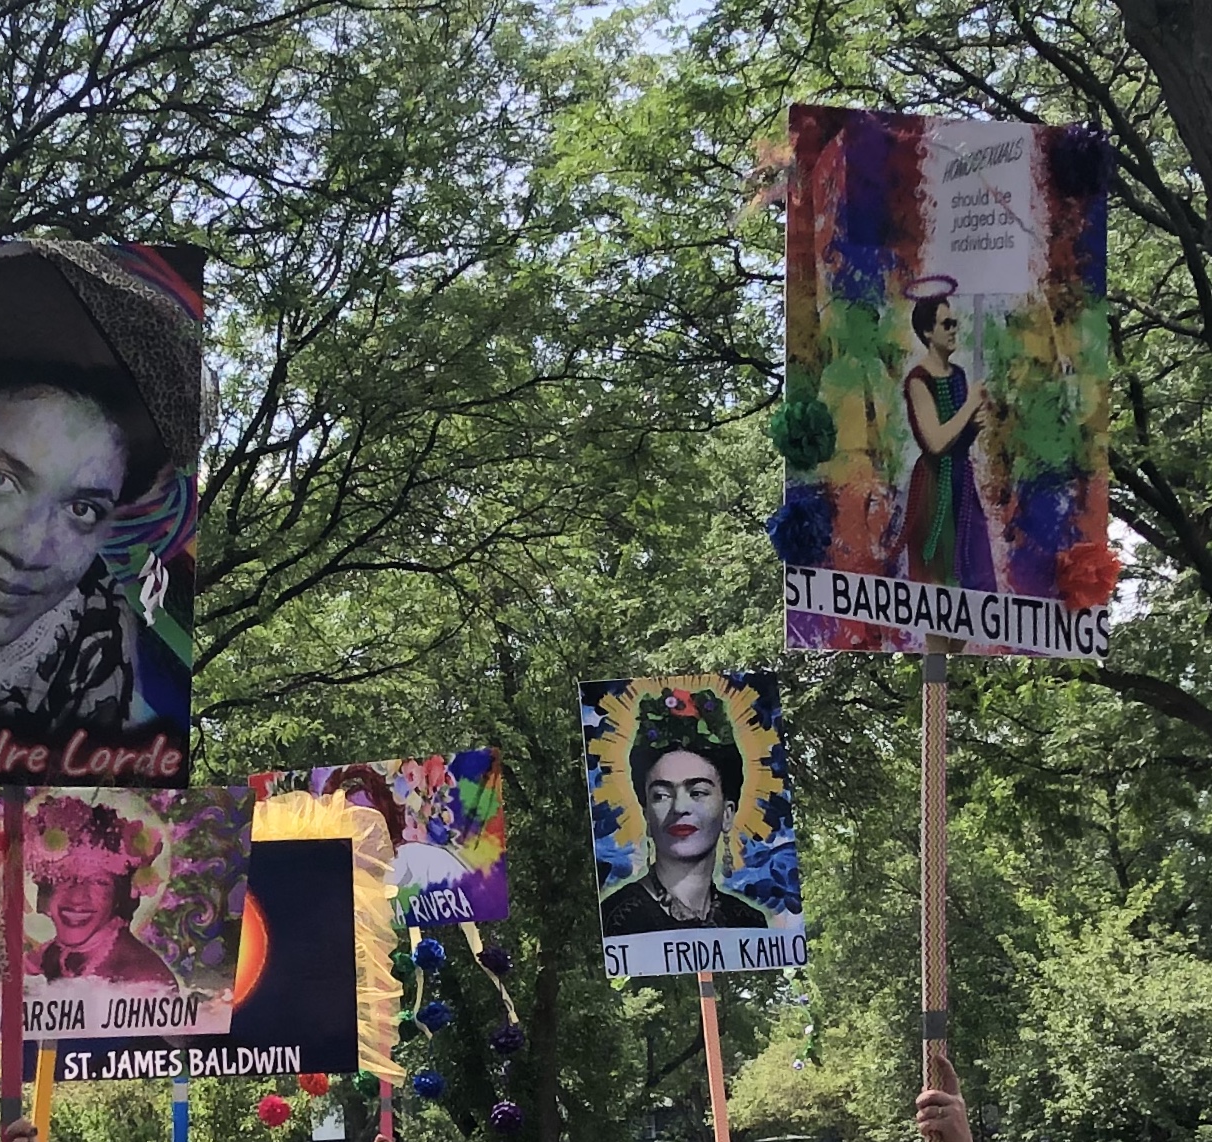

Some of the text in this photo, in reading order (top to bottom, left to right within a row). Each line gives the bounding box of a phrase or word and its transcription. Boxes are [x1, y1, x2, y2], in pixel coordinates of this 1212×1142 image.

[951, 186, 1012, 209] should be
[950, 209, 1015, 233] judged as
[950, 231, 1015, 252] individuals
[786, 566, 1110, 658] ST. BARBARA GITTINGS
[59, 728, 184, 778] Lorde
[408, 886, 475, 923] RIVERA
[663, 939, 726, 973] FRIDA
[738, 934, 808, 969] KAHLO
[0, 998, 86, 1032] ARSHA
[100, 996, 201, 1030] JOHNSON
[64, 1044, 302, 1081] ST. JAMES BALDWIN
